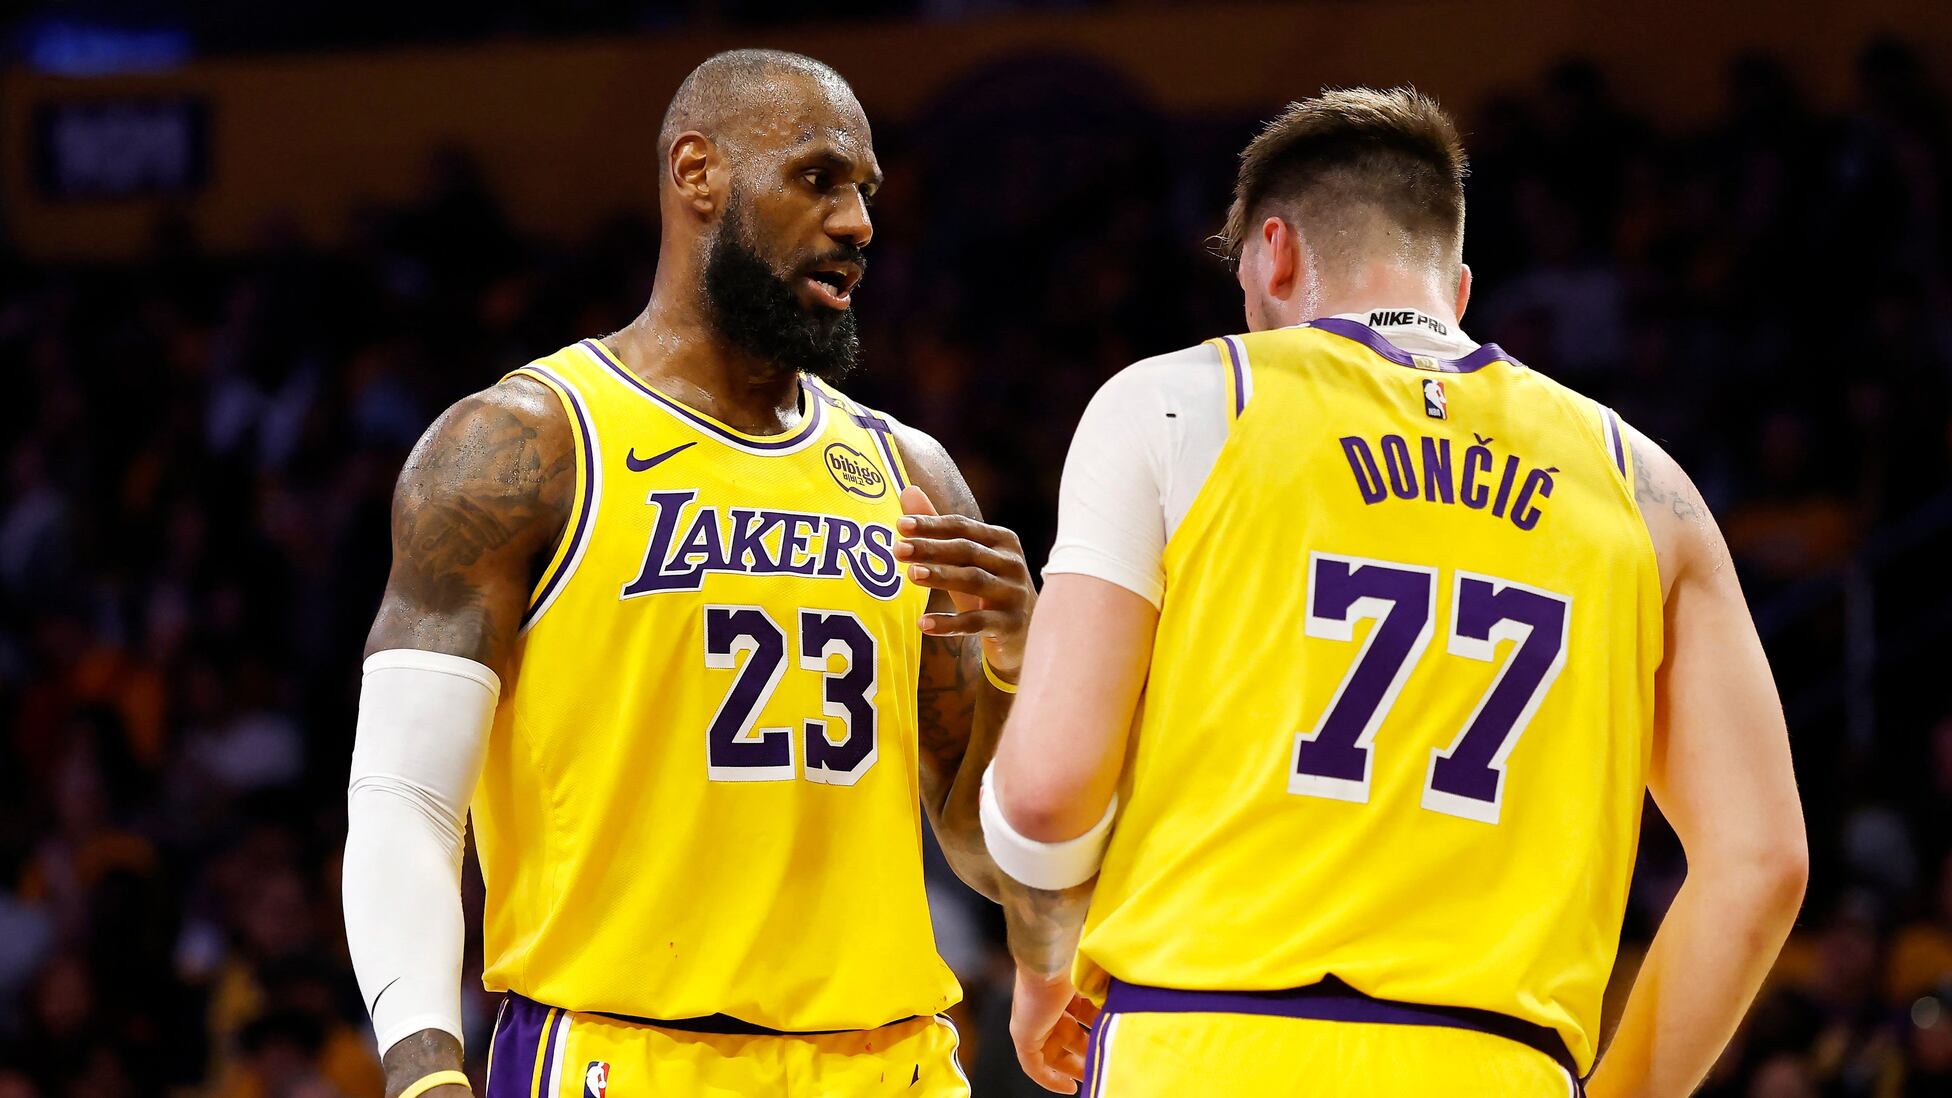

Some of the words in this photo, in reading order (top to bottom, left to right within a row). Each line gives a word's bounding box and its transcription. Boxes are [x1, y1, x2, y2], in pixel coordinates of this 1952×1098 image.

[1368, 311, 1415, 327] NIKE
[1417, 314, 1448, 336] PRO
[1427, 407, 1442, 417] NBA
[828, 453, 882, 486] bibigo
[842, 472, 866, 487] 비비고
[1339, 432, 1561, 532] DONČIĆ
[620, 489, 903, 601] LAKERS
[703, 604, 879, 786] 23
[1288, 551, 1573, 825] 77
